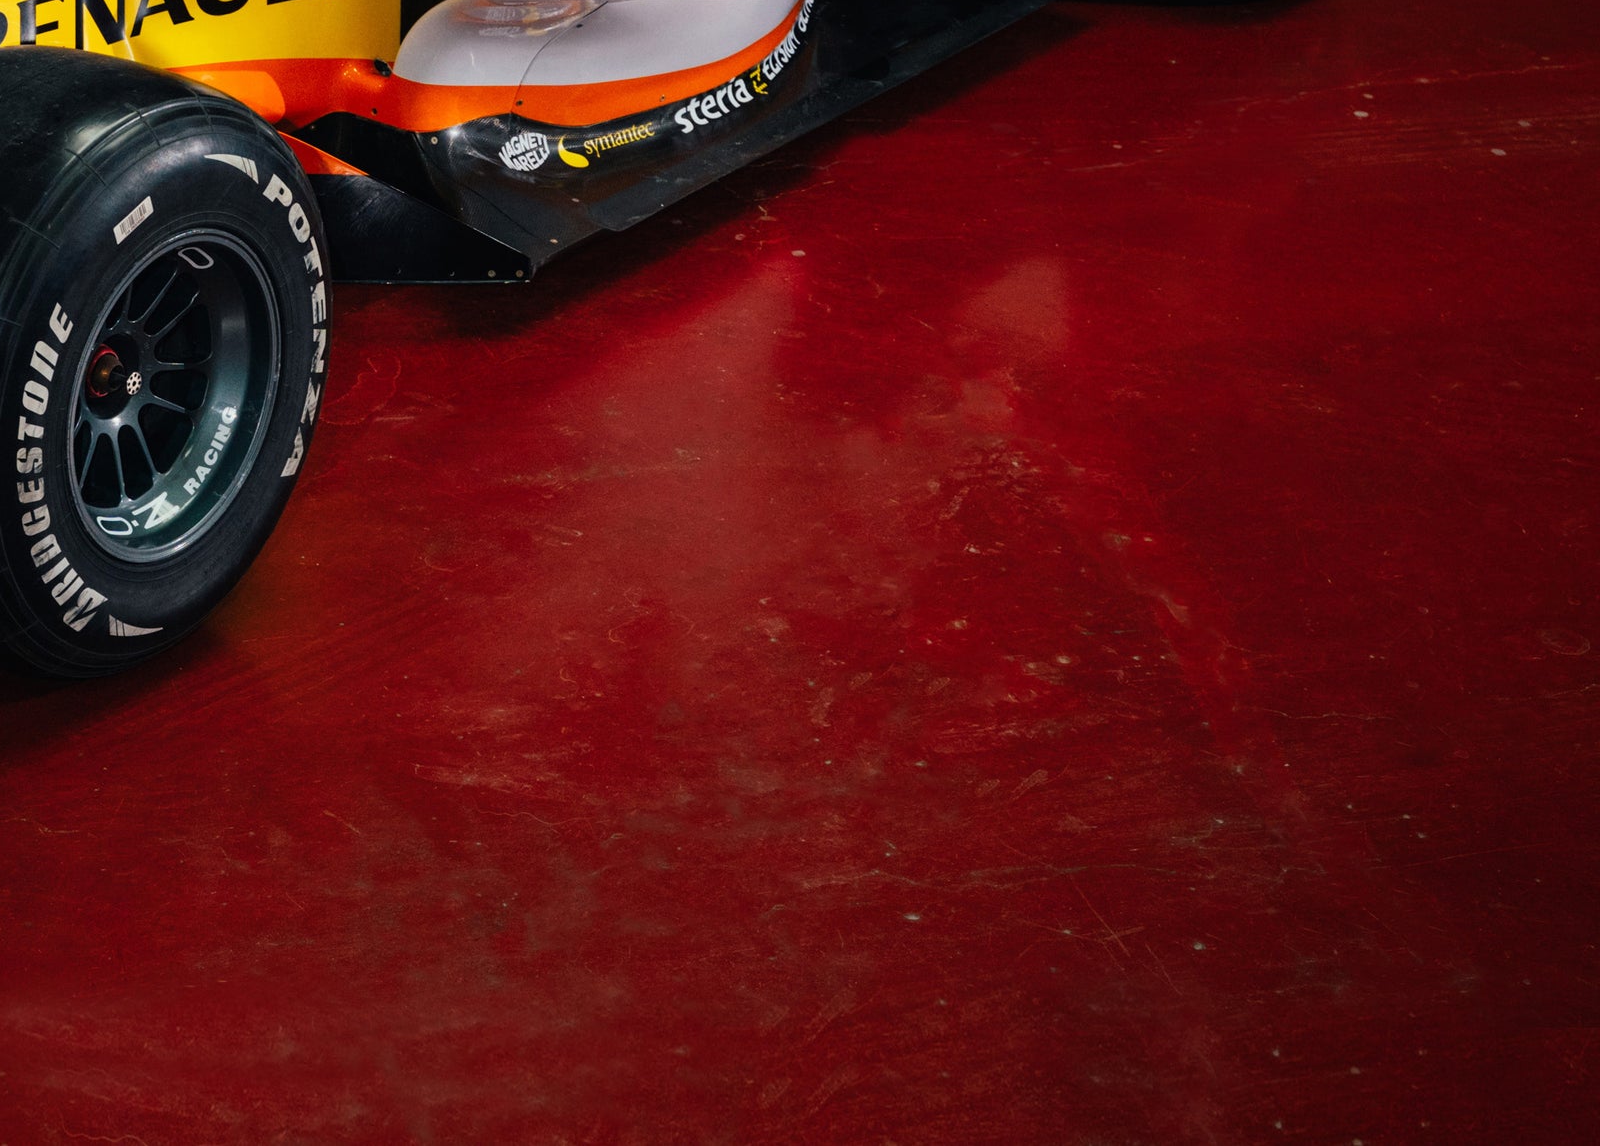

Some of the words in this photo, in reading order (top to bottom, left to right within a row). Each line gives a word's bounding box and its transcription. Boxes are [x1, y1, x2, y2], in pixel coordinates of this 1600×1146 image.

[583, 121, 656, 158] symantec
[674, 74, 754, 134] steria
[262, 173, 327, 477] POTENZA
[16, 302, 108, 632] BRIDGESTONE
[183, 405, 237, 496] RACING
